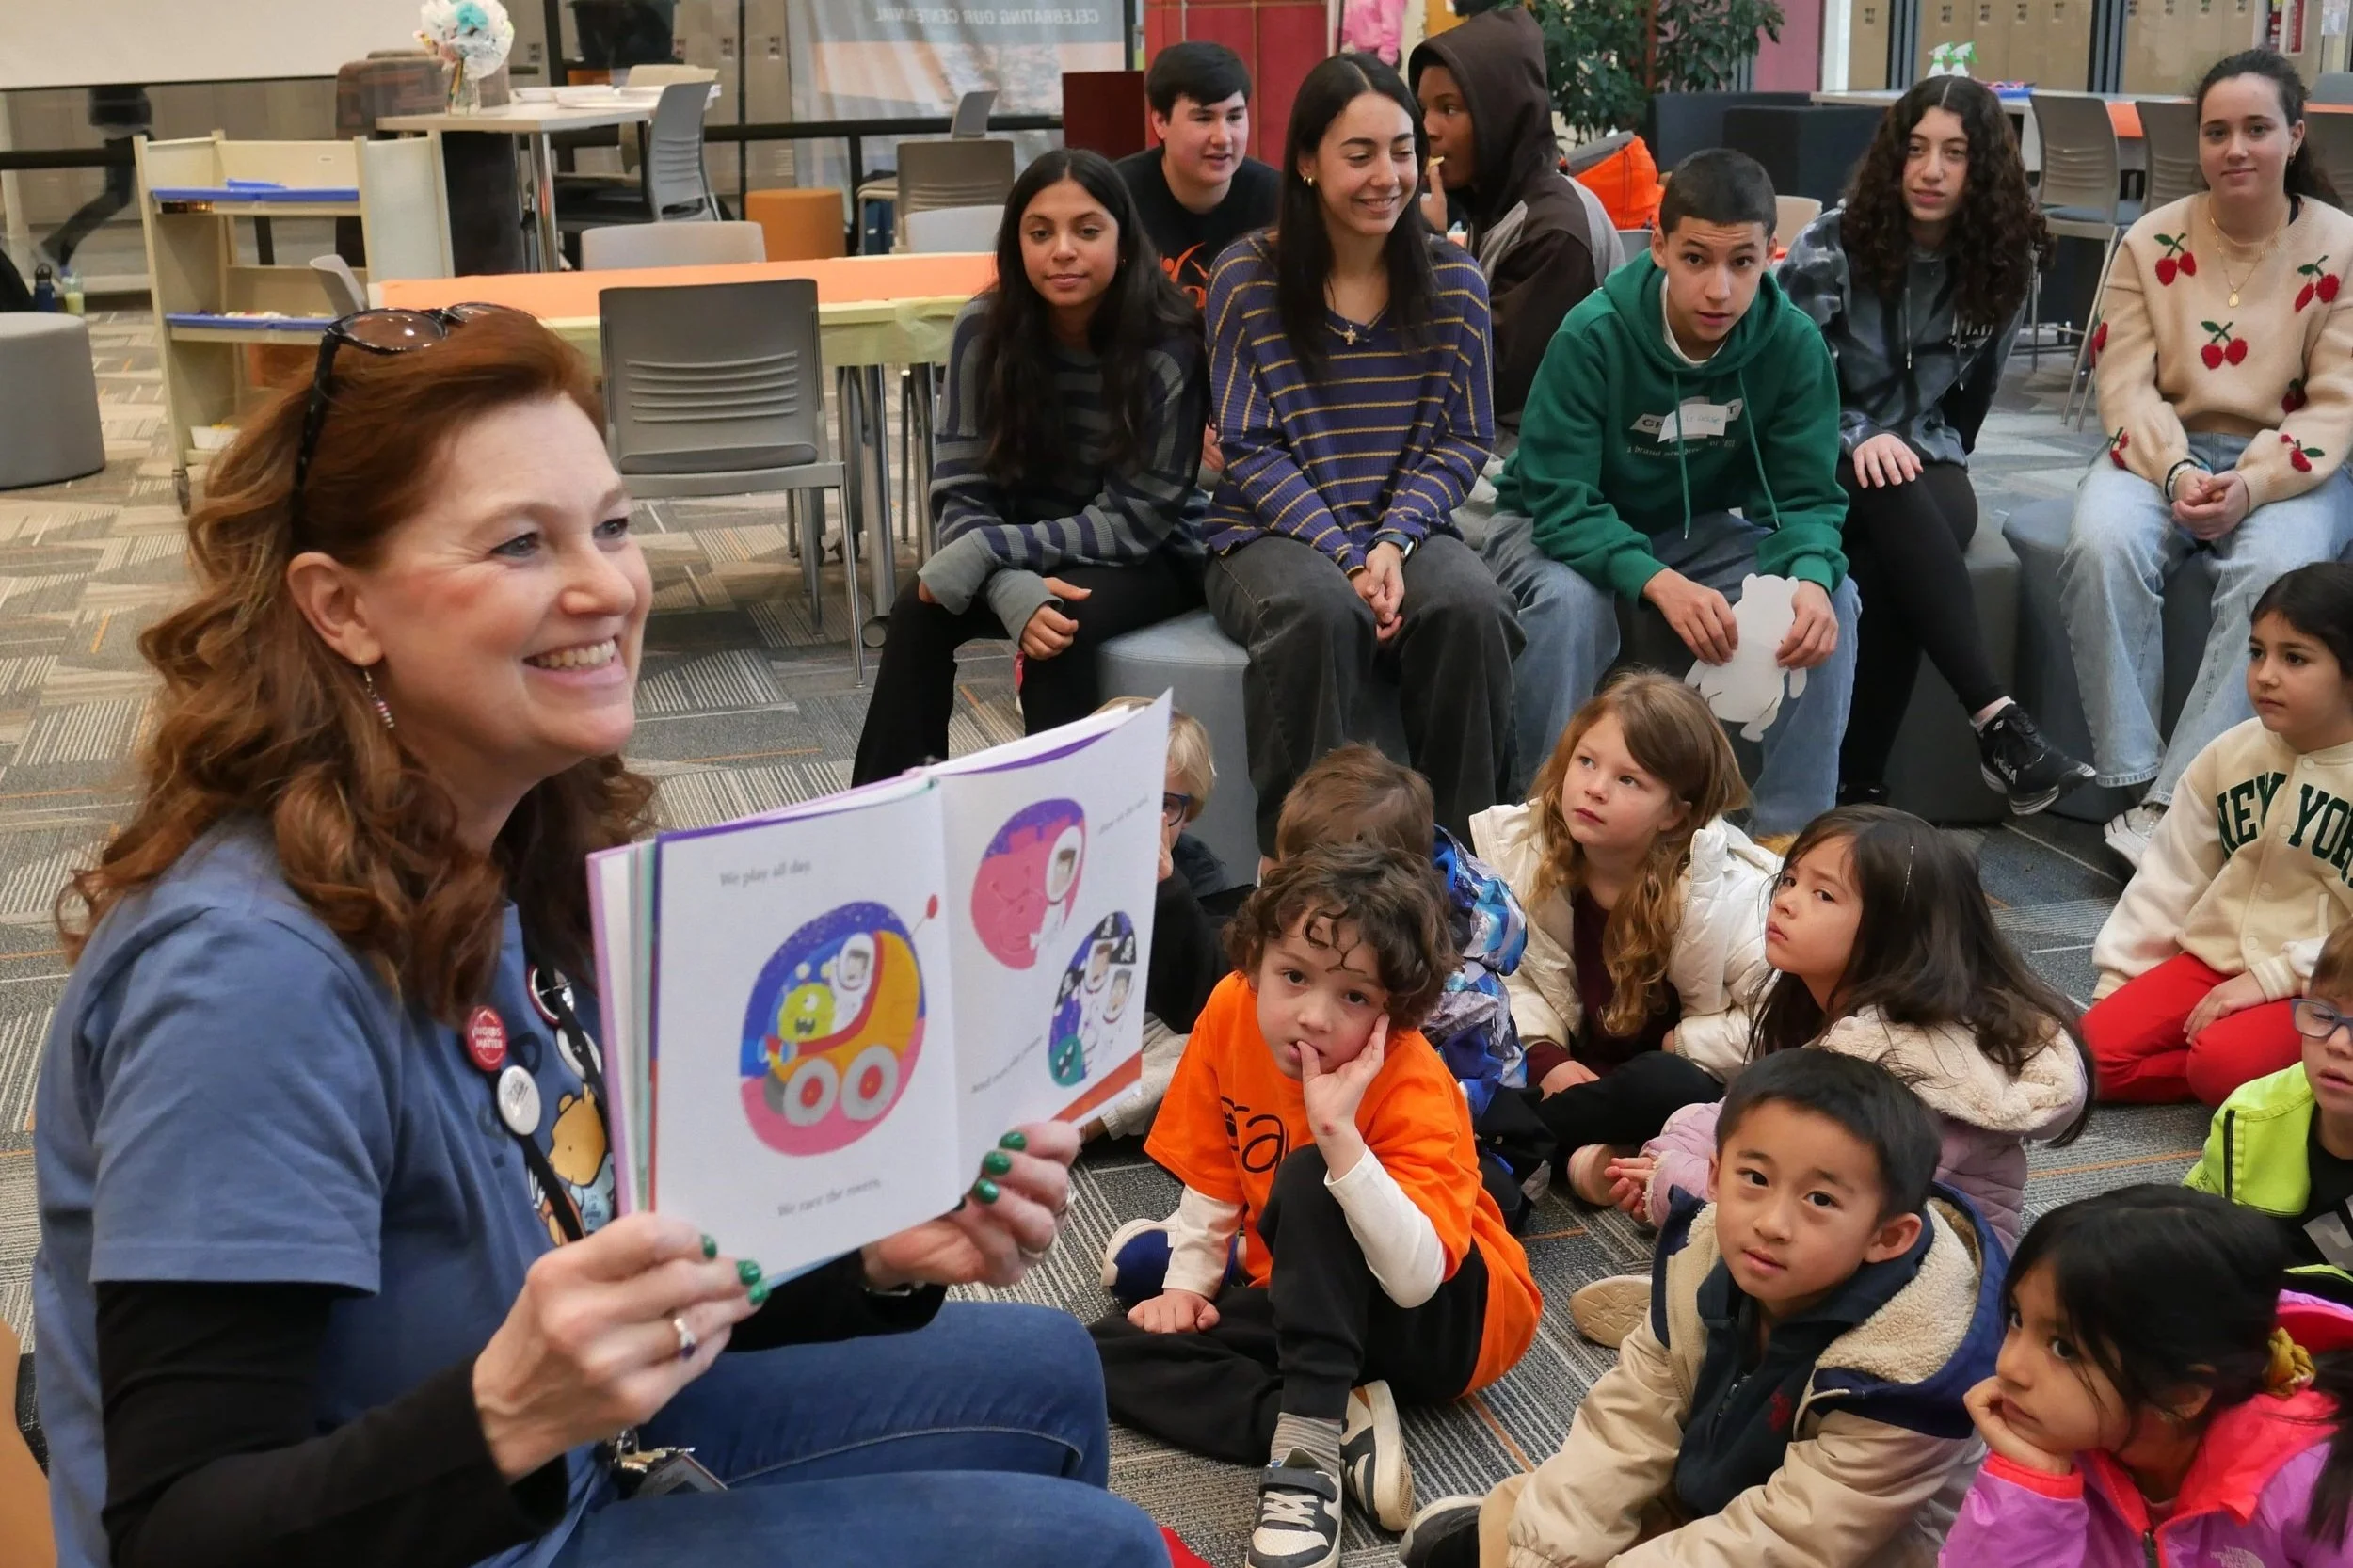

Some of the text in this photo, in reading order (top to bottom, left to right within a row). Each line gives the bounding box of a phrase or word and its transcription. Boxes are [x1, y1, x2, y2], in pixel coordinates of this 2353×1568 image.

[2287, 782, 2353, 889] YOR
[776, 1204, 796, 1217] We
[826, 1188, 844, 1204] the
